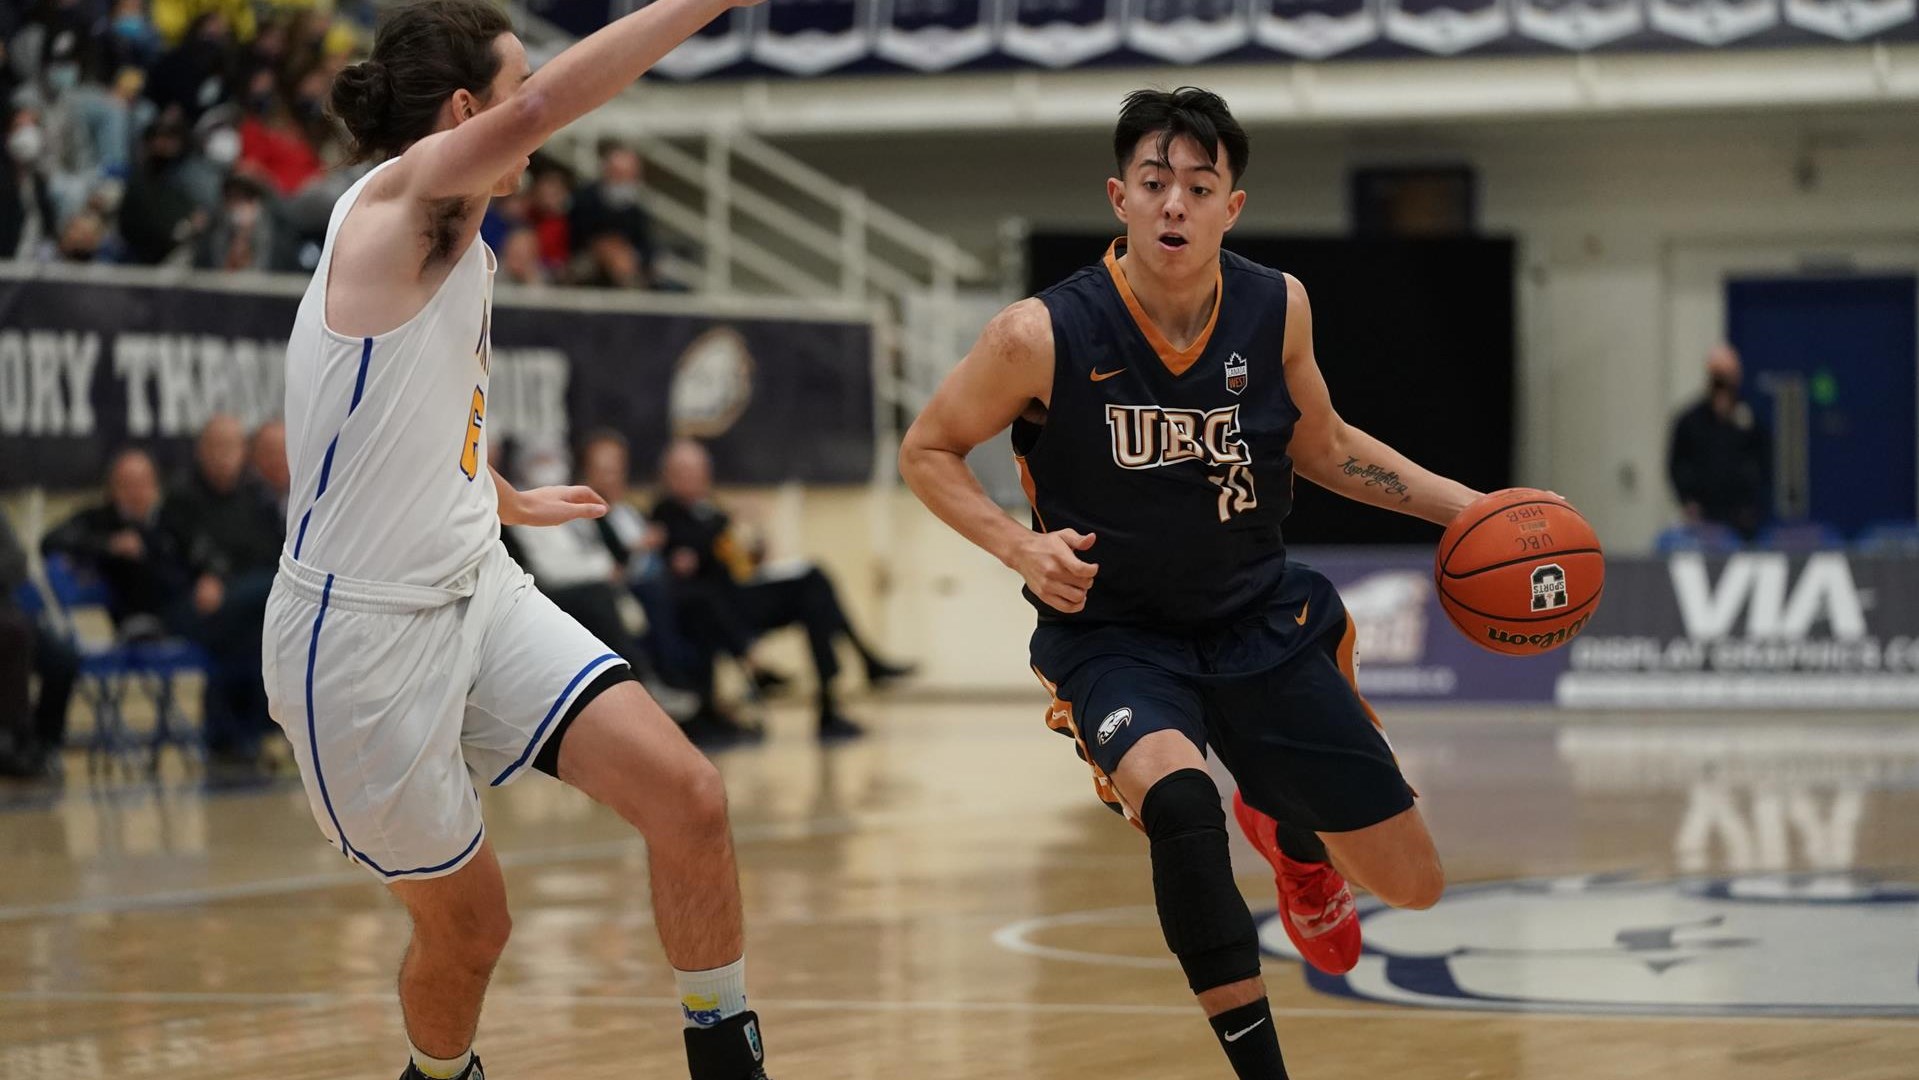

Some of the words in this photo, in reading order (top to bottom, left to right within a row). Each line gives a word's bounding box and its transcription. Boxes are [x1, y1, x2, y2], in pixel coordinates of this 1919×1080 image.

[1105, 404, 1252, 469] UBC
[1208, 465, 1257, 523] 10
[1515, 533, 1554, 551] UBC
[1534, 580, 1564, 595] SPORTS
[1668, 551, 1868, 640] VIA
[1487, 612, 1590, 649] Wilson
